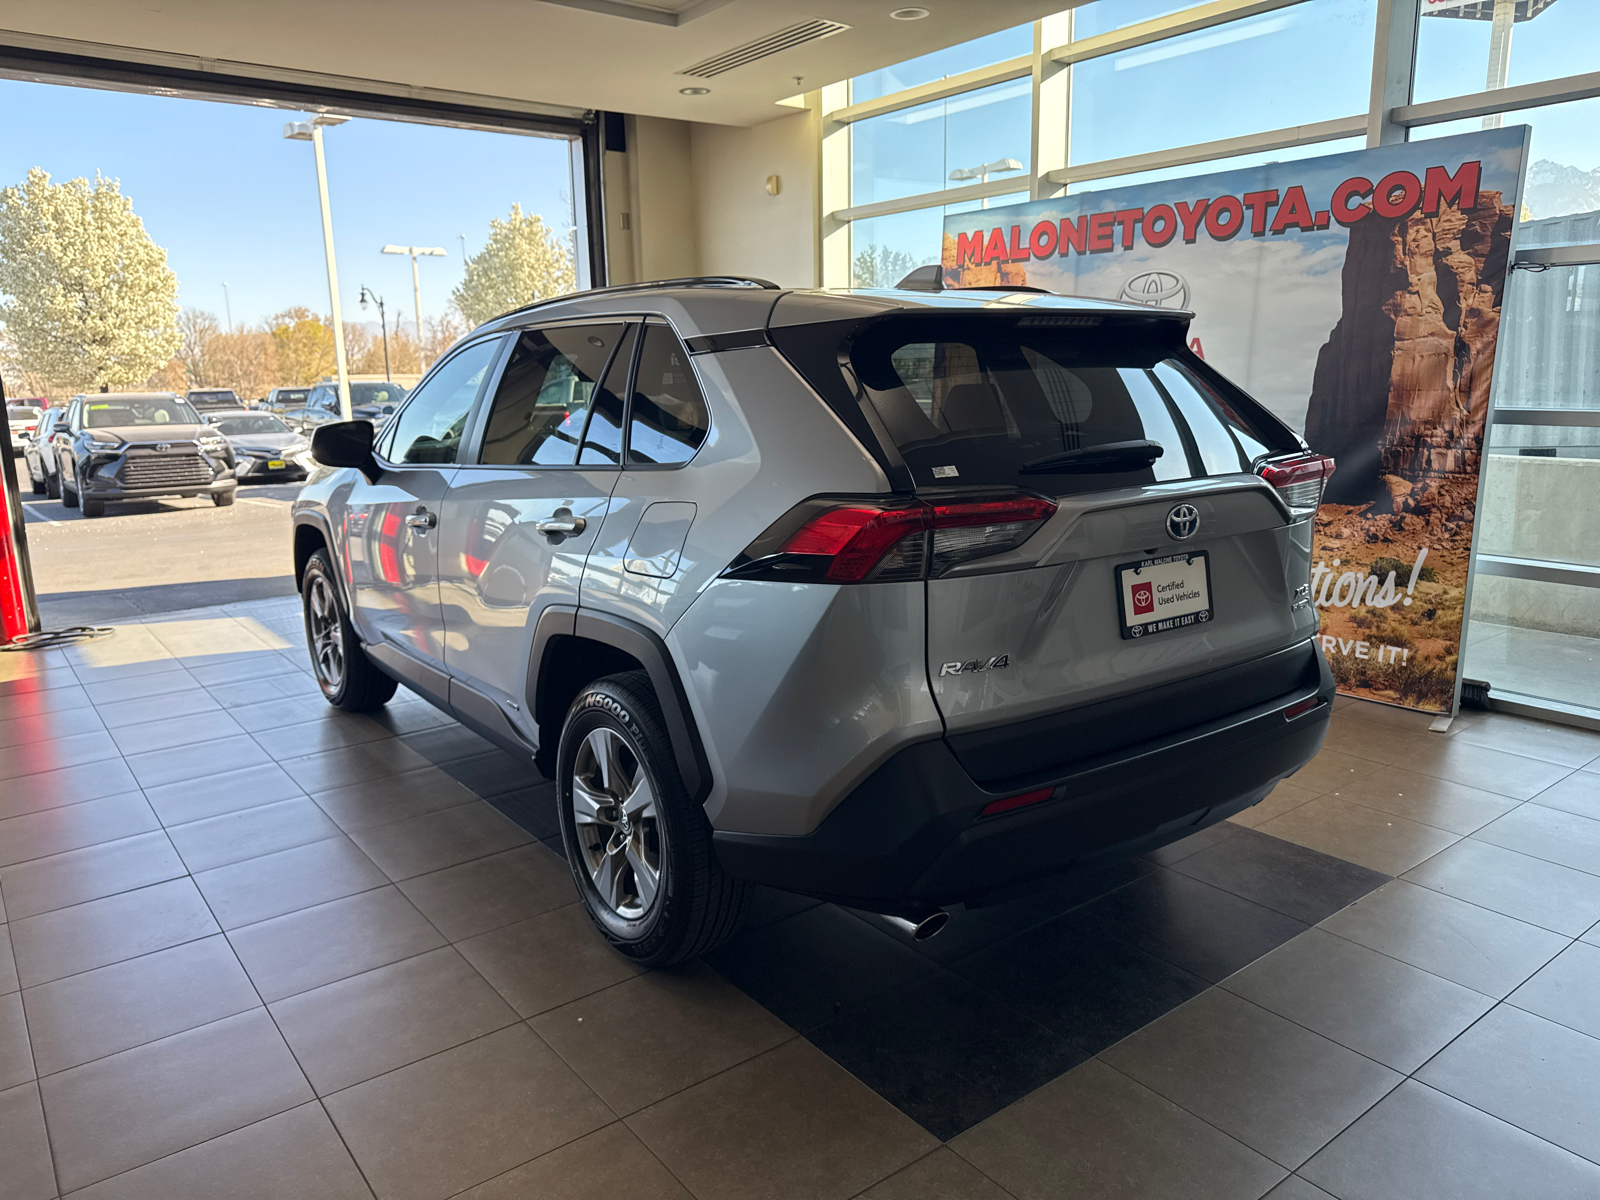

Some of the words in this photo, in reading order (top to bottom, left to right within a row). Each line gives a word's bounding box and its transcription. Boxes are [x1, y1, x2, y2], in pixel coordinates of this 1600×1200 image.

[956, 161, 1482, 268] MALONETOYOTA.COM
[1154, 556, 1172, 565] MALONE
[1173, 554, 1189, 562] TOYOTA
[1157, 580, 1184, 593] Certified
[1158, 594, 1175, 606] Used
[1175, 590, 1201, 602] Vehicles
[1148, 624, 1157, 633] WE
[1158, 619, 1174, 631] MAKE
[1175, 617, 1180, 627] IT
[1181, 614, 1195, 625] EASY
[1317, 634, 1370, 659] RVE
[1378, 645, 1409, 667] IT!
[939, 653, 1011, 677] RAV4
[585, 693, 630, 723] N5000
